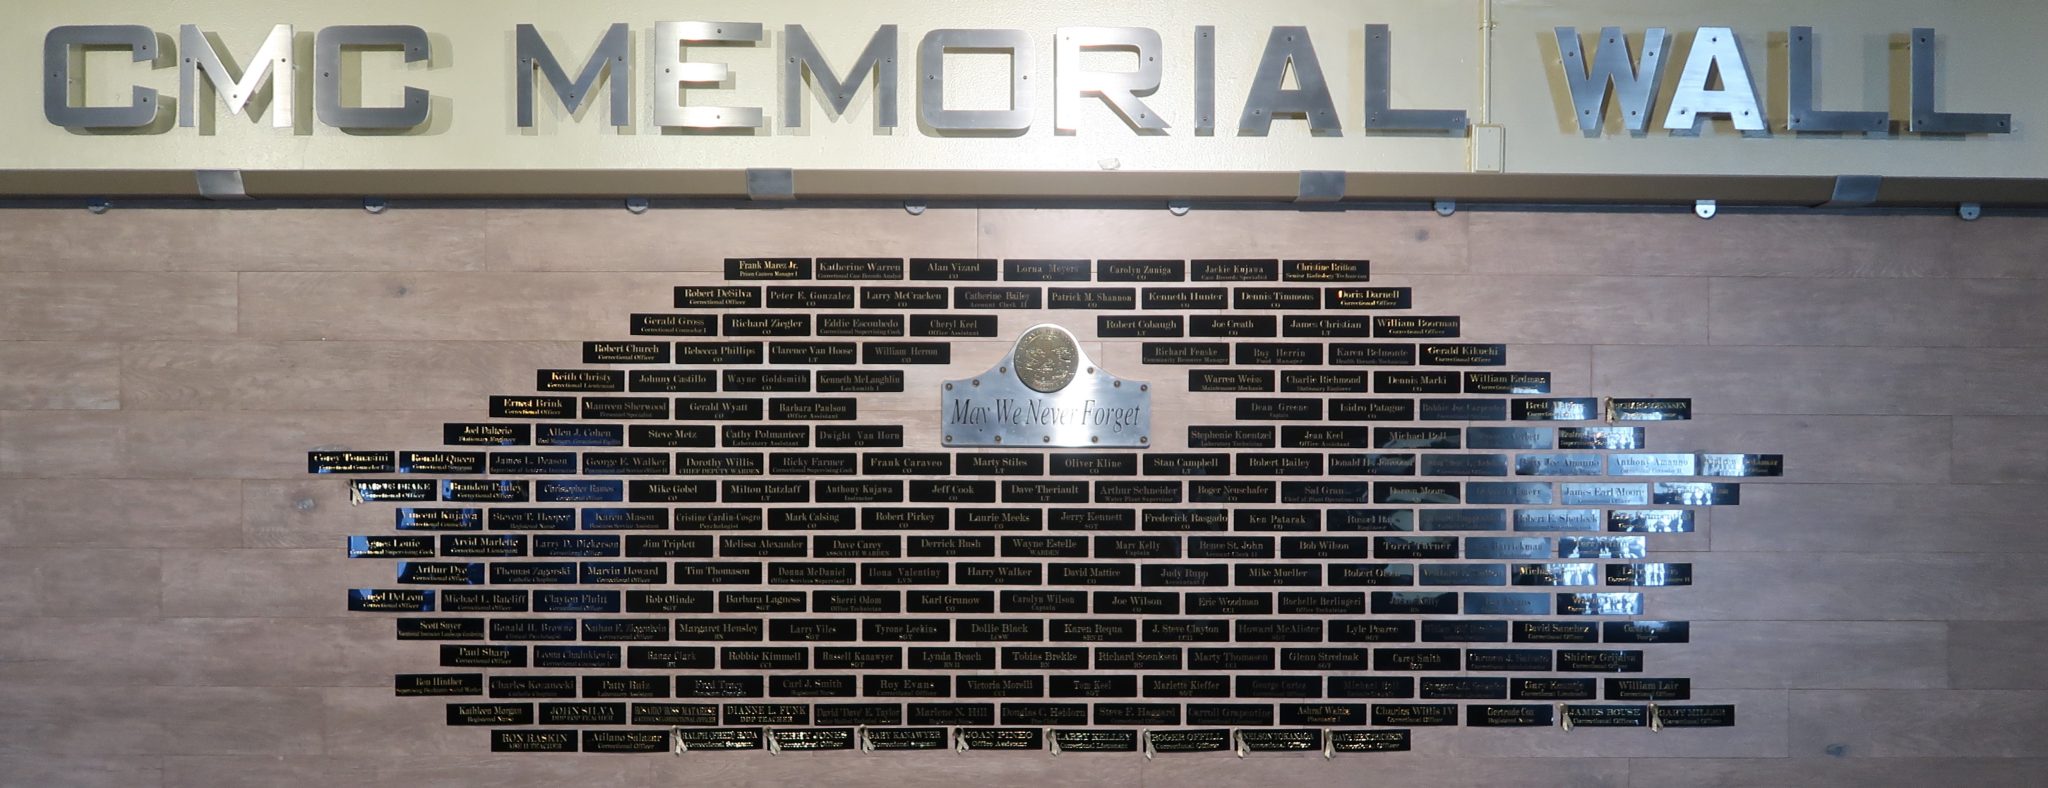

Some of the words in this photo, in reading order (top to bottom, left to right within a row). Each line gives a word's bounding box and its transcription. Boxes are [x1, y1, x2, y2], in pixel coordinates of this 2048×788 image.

[42, 24, 430, 128] CMC
[515, 20, 1467, 138] MEMORIAL
[1554, 25, 2012, 135] WALL
[739, 260, 762, 270] Frank
[788, 260, 798, 269] Jr.
[819, 262, 865, 271] Katherine
[867, 262, 901, 271] Warren
[927, 262, 949, 271] Alan
[951, 262, 980, 272] Vizard
[1108, 264, 1141, 275] Carolyn
[1143, 265, 1172, 275] Zuniga
[1296, 262, 1330, 271] Christine
[684, 288, 714, 298] Robert
[717, 288, 752, 298] DeSilva
[770, 291, 794, 300] Peter
[797, 291, 807, 300] E.
[809, 291, 851, 300] Gonzalez
[866, 291, 891, 300] Larry
[894, 291, 942, 300] McCracken
[1052, 292, 1082, 301] Patrick
[1084, 292, 1094, 302] M.
[1096, 292, 1132, 302] Shannon
[1149, 292, 1187, 301] Kenneth
[1190, 292, 1223, 301] Hunter
[1241, 292, 1272, 300] Dennis
[1272, 292, 1314, 300] Timmons
[1337, 290, 1364, 299] Doris
[1366, 290, 1400, 298] Darnell
[732, 319, 768, 328] Richard
[771, 319, 803, 329] Ziegler
[930, 319, 957, 330] Cheryl
[959, 319, 977, 329] Keel
[1106, 320, 1136, 329] Robert
[1137, 320, 1177, 329] Cobaugh
[1211, 319, 1226, 328] Joe
[1290, 320, 1318, 328] James
[1319, 320, 1362, 329] Christian
[1377, 318, 1415, 327] William
[594, 344, 624, 353] Robert
[625, 344, 659, 353] Church
[771, 346, 808, 354] Clarence
[809, 346, 826, 355] Van
[828, 346, 853, 355] Hoose
[551, 372, 577, 381] Keith
[579, 373, 611, 381] Christy
[639, 374, 670, 383] Johnny
[672, 374, 707, 383] Castillo
[1286, 375, 1317, 384] Charlie
[1319, 375, 1361, 384] Richmond
[1388, 376, 1418, 384] Dennis
[1420, 375, 1447, 384] Marki
[503, 398, 533, 407] Ernest
[536, 399, 562, 407] Brink
[689, 402, 719, 411] Gerald
[721, 402, 748, 411] Wyatt
[779, 403, 812, 412] Barbara
[814, 403, 847, 412] Paulson
[950, 398, 990, 425] May
[994, 398, 1023, 425] We
[1025, 398, 1078, 425] Never
[1081, 398, 1141, 433] Forget
[648, 430, 673, 438] Steve
[675, 429, 697, 439] Metz
[725, 430, 751, 439] Cathy
[754, 430, 806, 439] Polmanteer
[686, 458, 722, 467] Dorothy
[725, 457, 754, 467] Willis
[870, 457, 900, 467] Frank
[903, 458, 943, 467] Caraveo
[973, 457, 999, 466] Marty
[1002, 457, 1028, 467] Stiles
[1153, 458, 1175, 467] Stan
[1176, 458, 1218, 468] Campbell
[1249, 457, 1278, 467] Robert
[1281, 458, 1309, 467] Bailey
[649, 484, 672, 493] Mike
[672, 484, 698, 493] Gobel
[731, 484, 762, 494] Milton
[764, 484, 801, 494] Ratzlaff
[931, 484, 951, 494] Jeff
[951, 485, 974, 494] Cook
[1011, 484, 1034, 494] Dave
[1034, 484, 1079, 494] Theriault
[875, 511, 904, 521] Robert
[907, 512, 935, 521] Pirkey
[642, 539, 660, 548] Jim
[661, 539, 695, 549] Triplett
[724, 539, 757, 548] Melissa
[759, 539, 803, 548] Alexander
[1012, 538, 1044, 550] Wayne
[1046, 538, 1077, 548] Estelle
[1299, 540, 1317, 550] Bob
[1319, 540, 1349, 550] Wilson
[684, 566, 704, 575] Tim
[705, 566, 750, 575] Thomason
[967, 566, 994, 578] Harry
[998, 567, 1033, 576] Walker
[1063, 567, 1088, 577] David
[1249, 568, 1272, 577] Mike
[1273, 568, 1308, 577] Mueller
[645, 594, 663, 604] Rob
[1111, 596, 1128, 605] Joe
[1129, 596, 1162, 606] Wilson
[679, 623, 720, 634] Margaret
[723, 623, 758, 633] Hensley
[971, 623, 1000, 633] Dollie
[1001, 623, 1029, 633] Black
[1525, 623, 1551, 632] David
[1551, 623, 1590, 632] Sanchez
[728, 651, 760, 661] Robbie
[1011, 651, 1043, 661] Tobias
[1044, 651, 1078, 661] Brekke
[967, 680, 1001, 690] Victoria
[1617, 680, 1656, 691] William
[1658, 680, 1680, 690] Lair
[550, 706, 579, 715] JOHN
[727, 705, 765, 715] DIANNE
[767, 705, 777, 715] L.
[779, 705, 806, 715] FUNK
[502, 733, 524, 743] RON
[812, 731, 848, 740] JONES
[964, 730, 996, 740] JOAN
